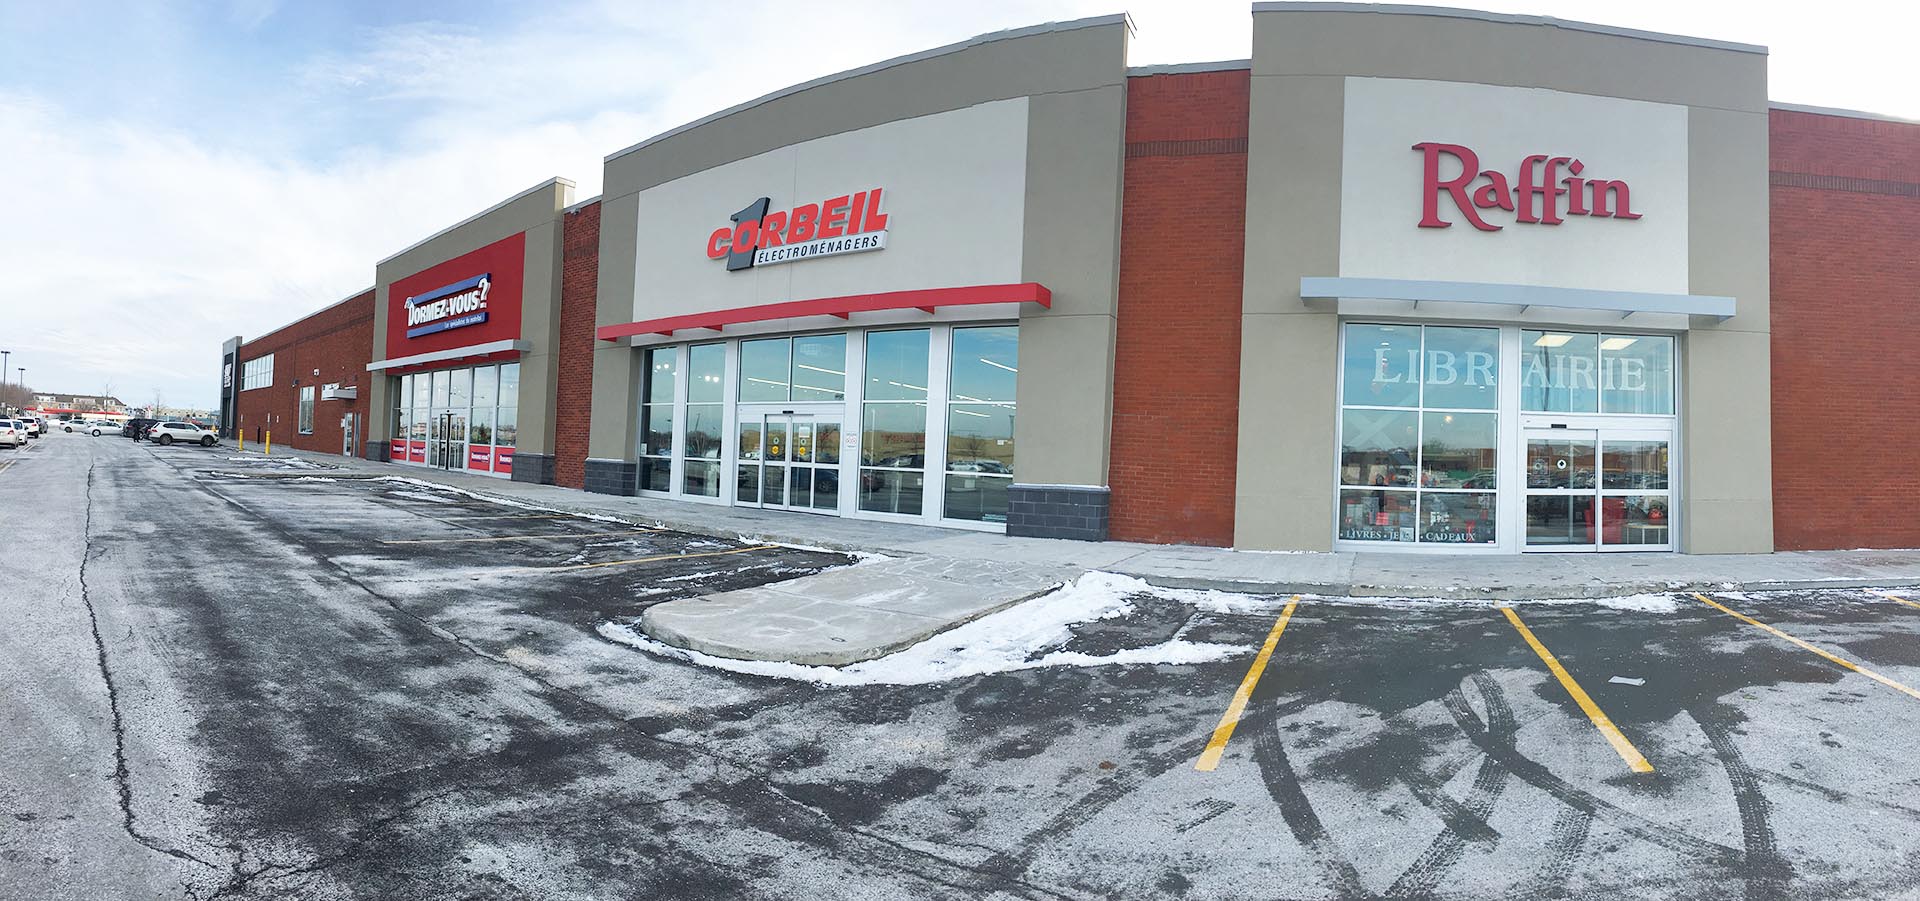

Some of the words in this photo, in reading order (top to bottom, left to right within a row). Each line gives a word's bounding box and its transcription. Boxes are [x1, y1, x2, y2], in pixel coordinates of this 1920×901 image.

[1411, 142, 1643, 231] Raffin
[707, 186, 890, 260] CORBEIL
[758, 235, 879, 264] ÉLECTROMÉNAGERS
[1346, 530, 1382, 540] LIVRES
[1426, 532, 1476, 542] CADEAUX
